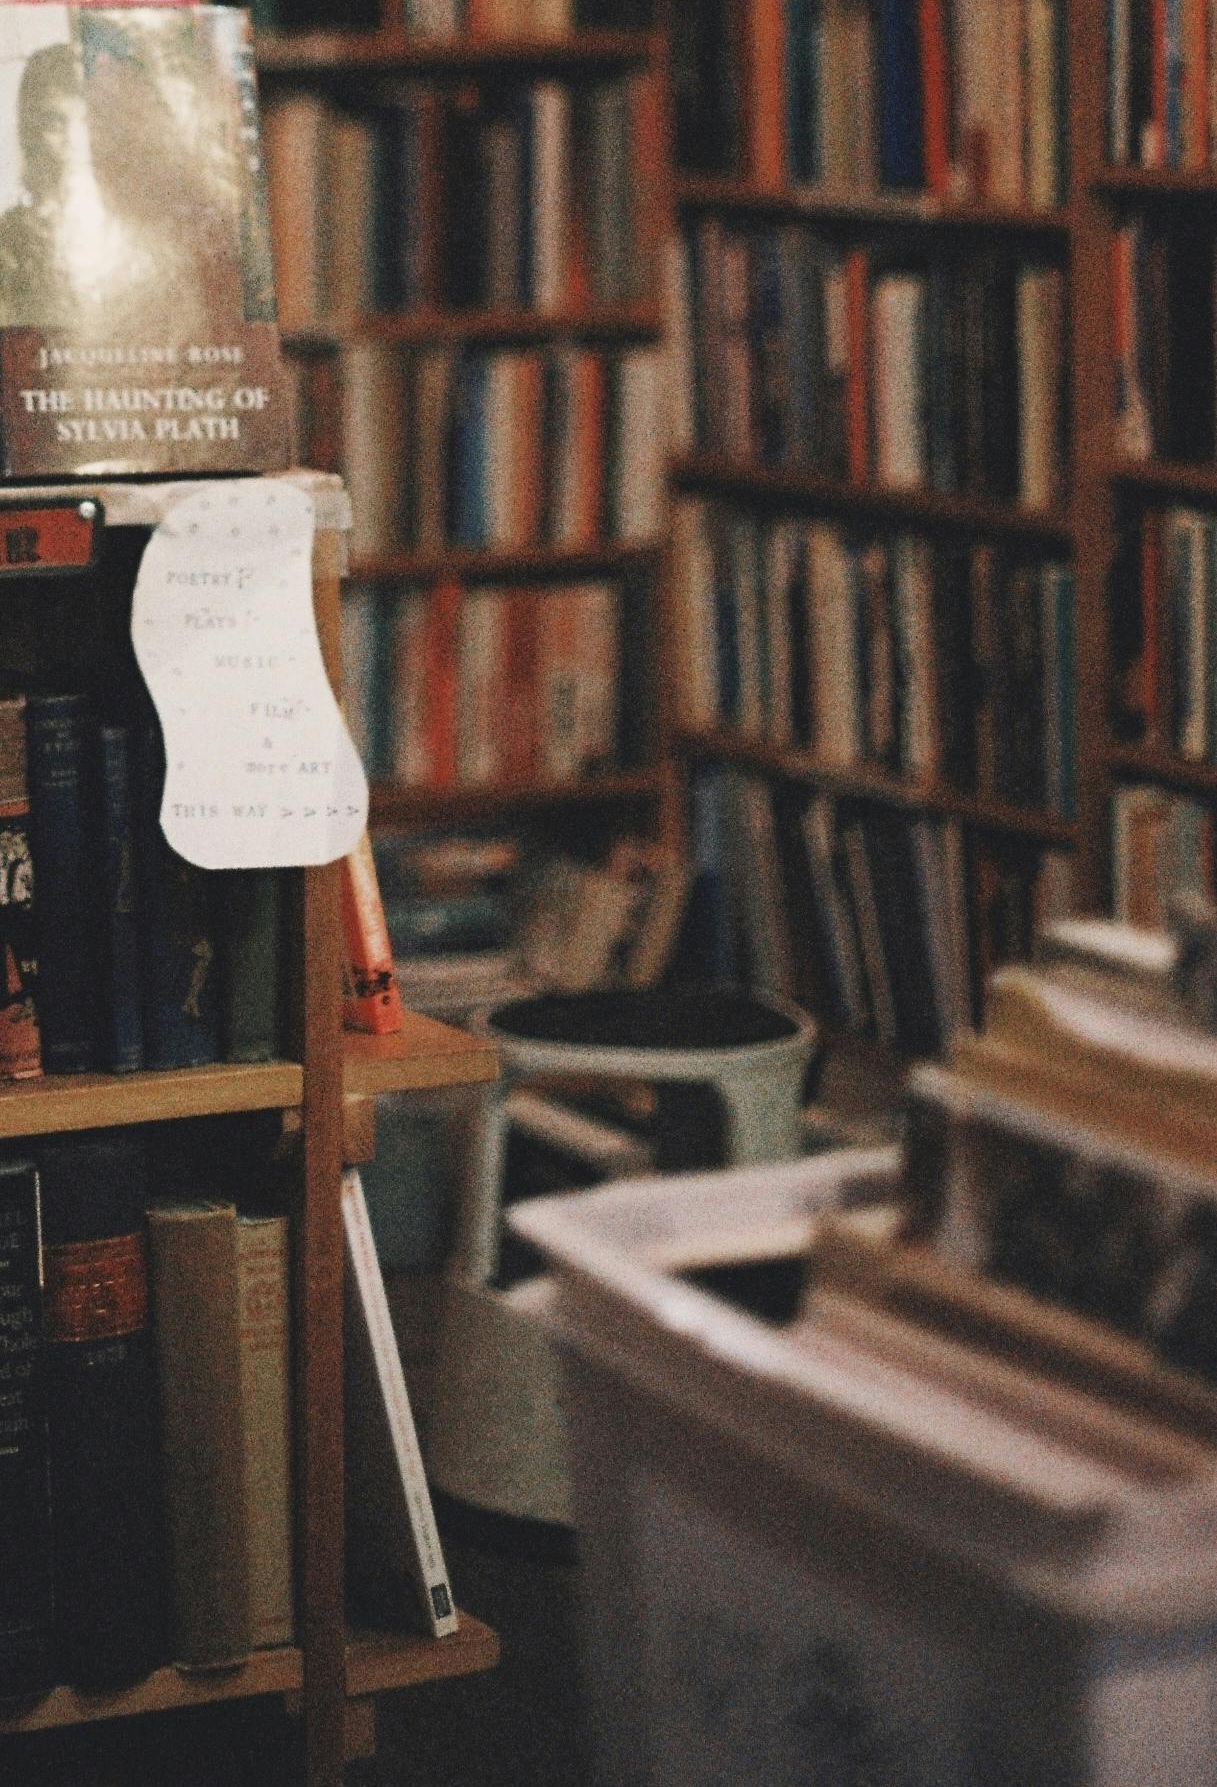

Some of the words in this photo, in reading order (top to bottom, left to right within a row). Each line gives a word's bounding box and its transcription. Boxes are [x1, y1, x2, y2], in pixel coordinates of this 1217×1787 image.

[20, 388, 70, 412] THE
[83, 386, 226, 412] HAUNTING
[233, 386, 270, 410] OF
[56, 418, 146, 442] SYLVIA
[155, 416, 239, 441] PLATH
[298, 761, 332, 774] ART
[170, 803, 219, 819] THIS
[232, 804, 269, 819] WAY
